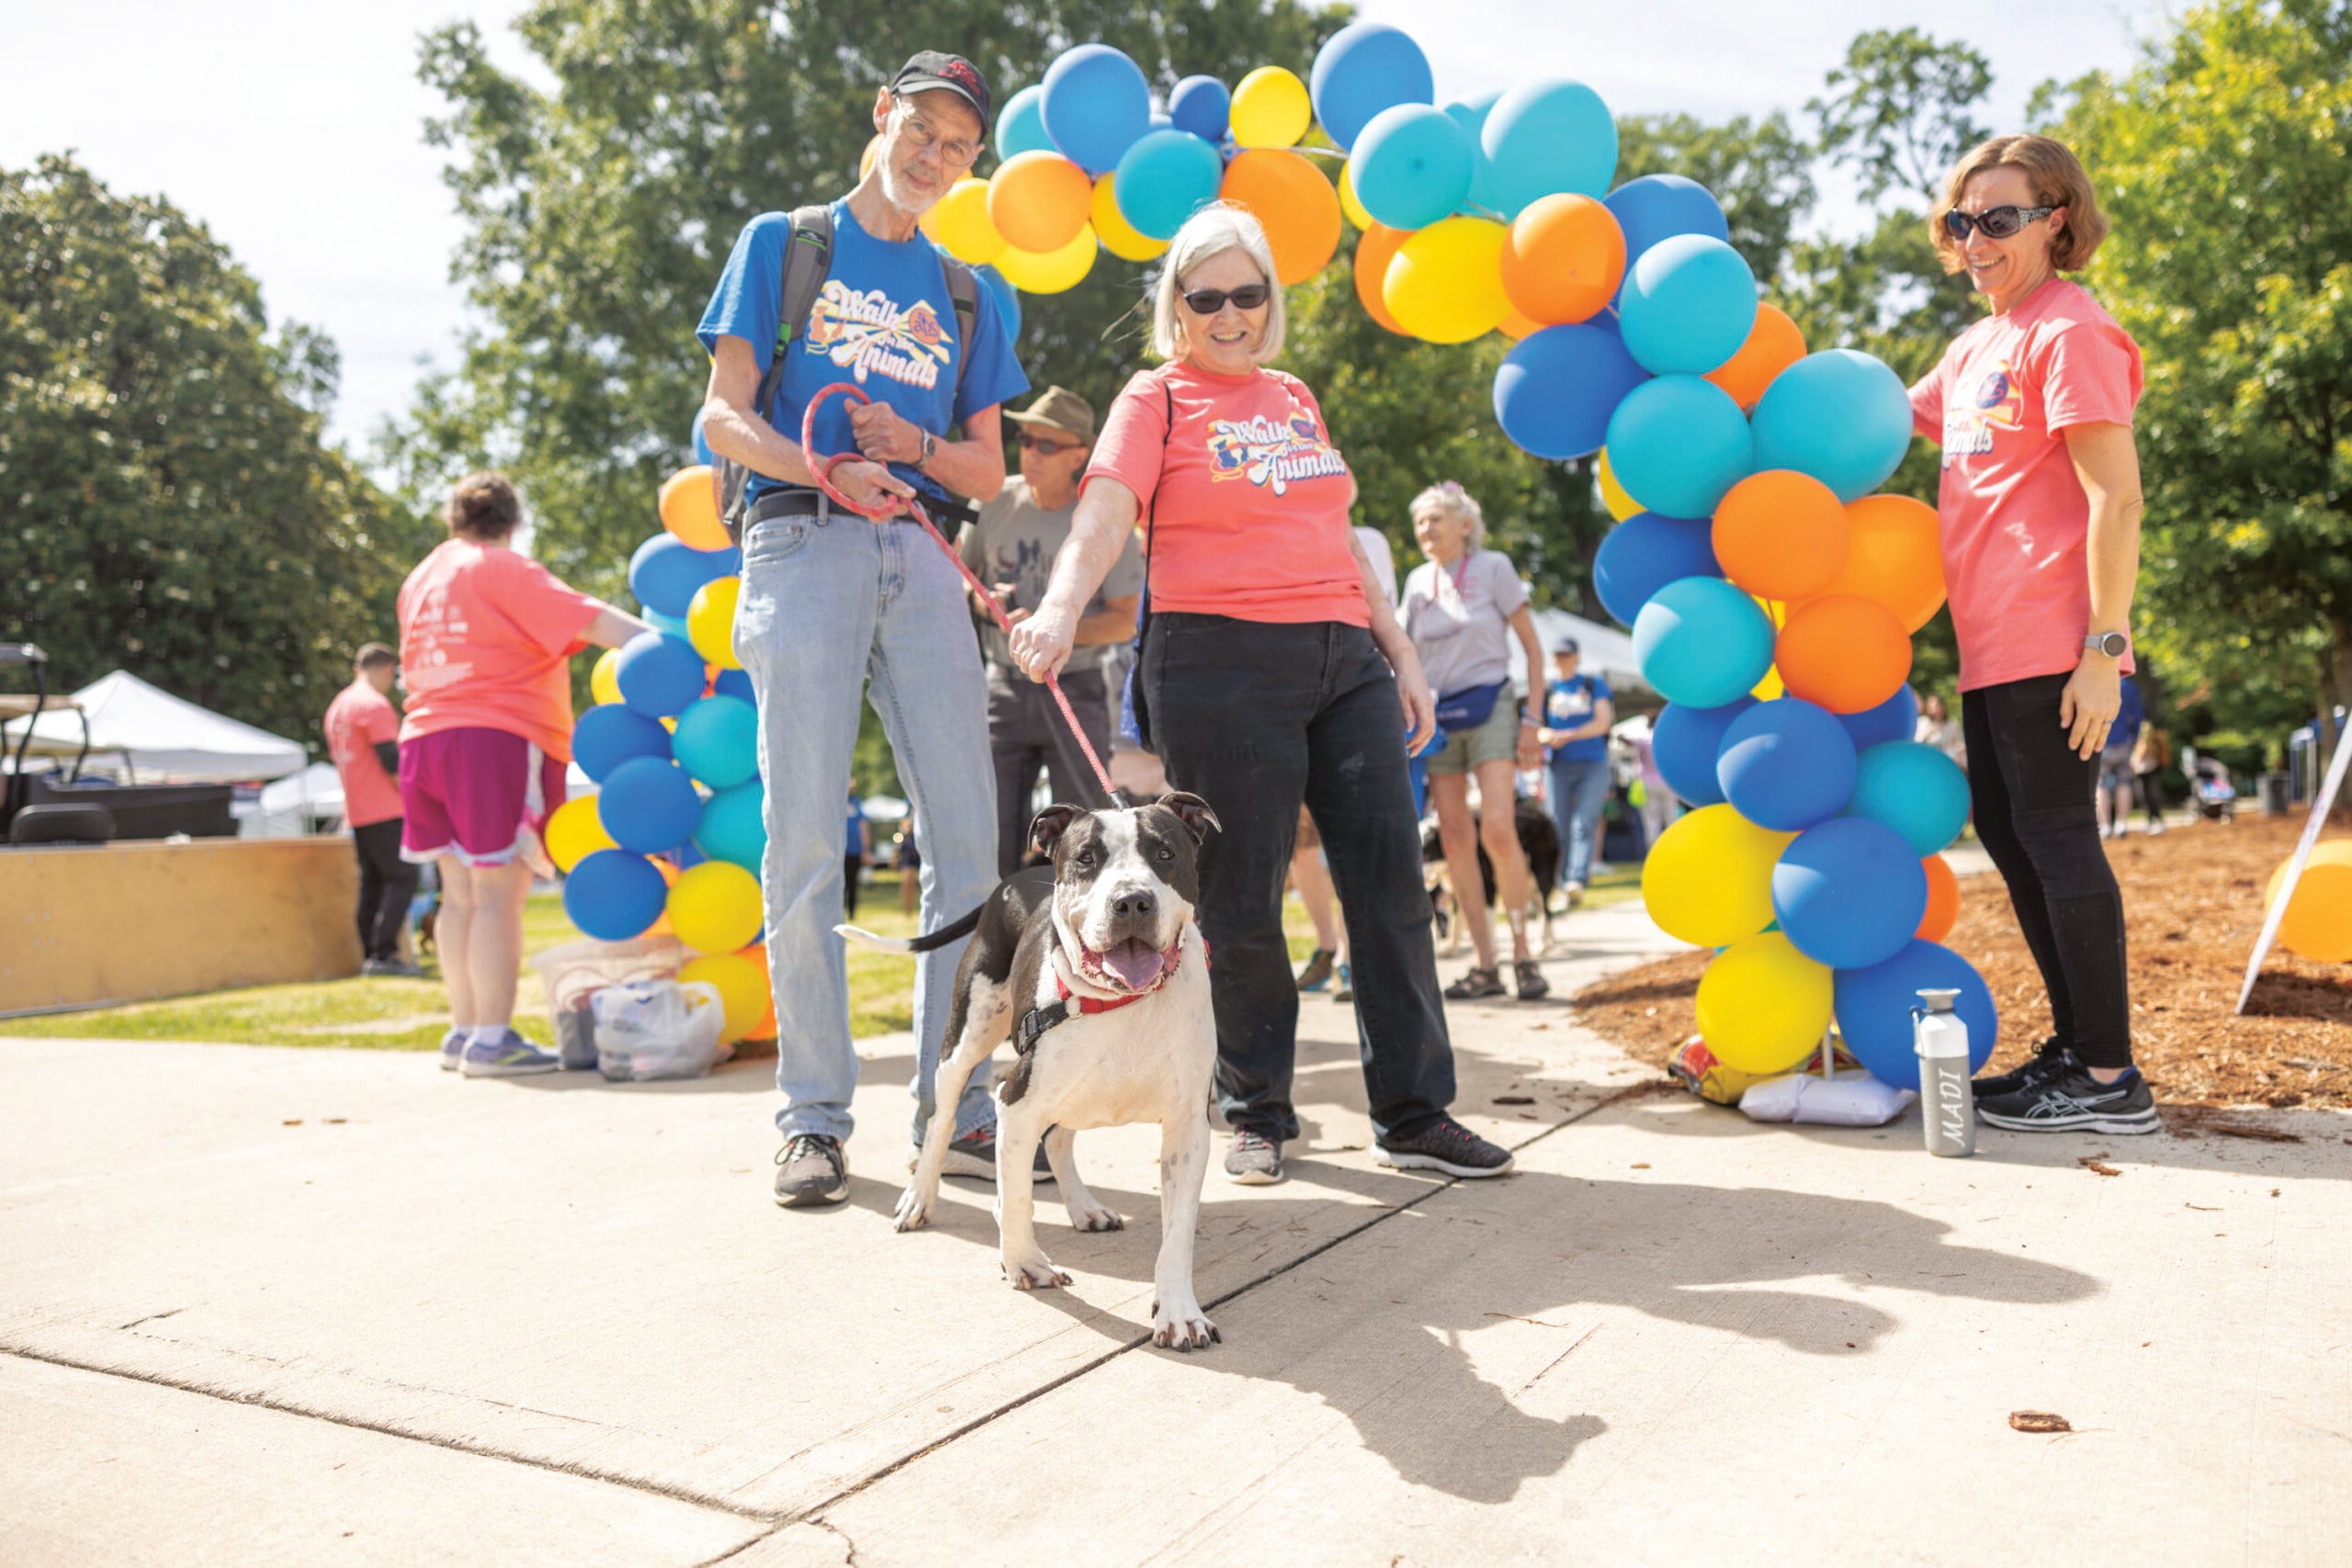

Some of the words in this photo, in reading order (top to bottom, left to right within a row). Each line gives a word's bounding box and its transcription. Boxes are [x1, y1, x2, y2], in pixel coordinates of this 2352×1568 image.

[824, 283, 901, 332] Walk
[830, 325, 938, 390] Animals
[1216, 414, 1292, 446] Walk
[1247, 447, 1346, 497] Animals
[1939, 1066, 1965, 1147] MADI
